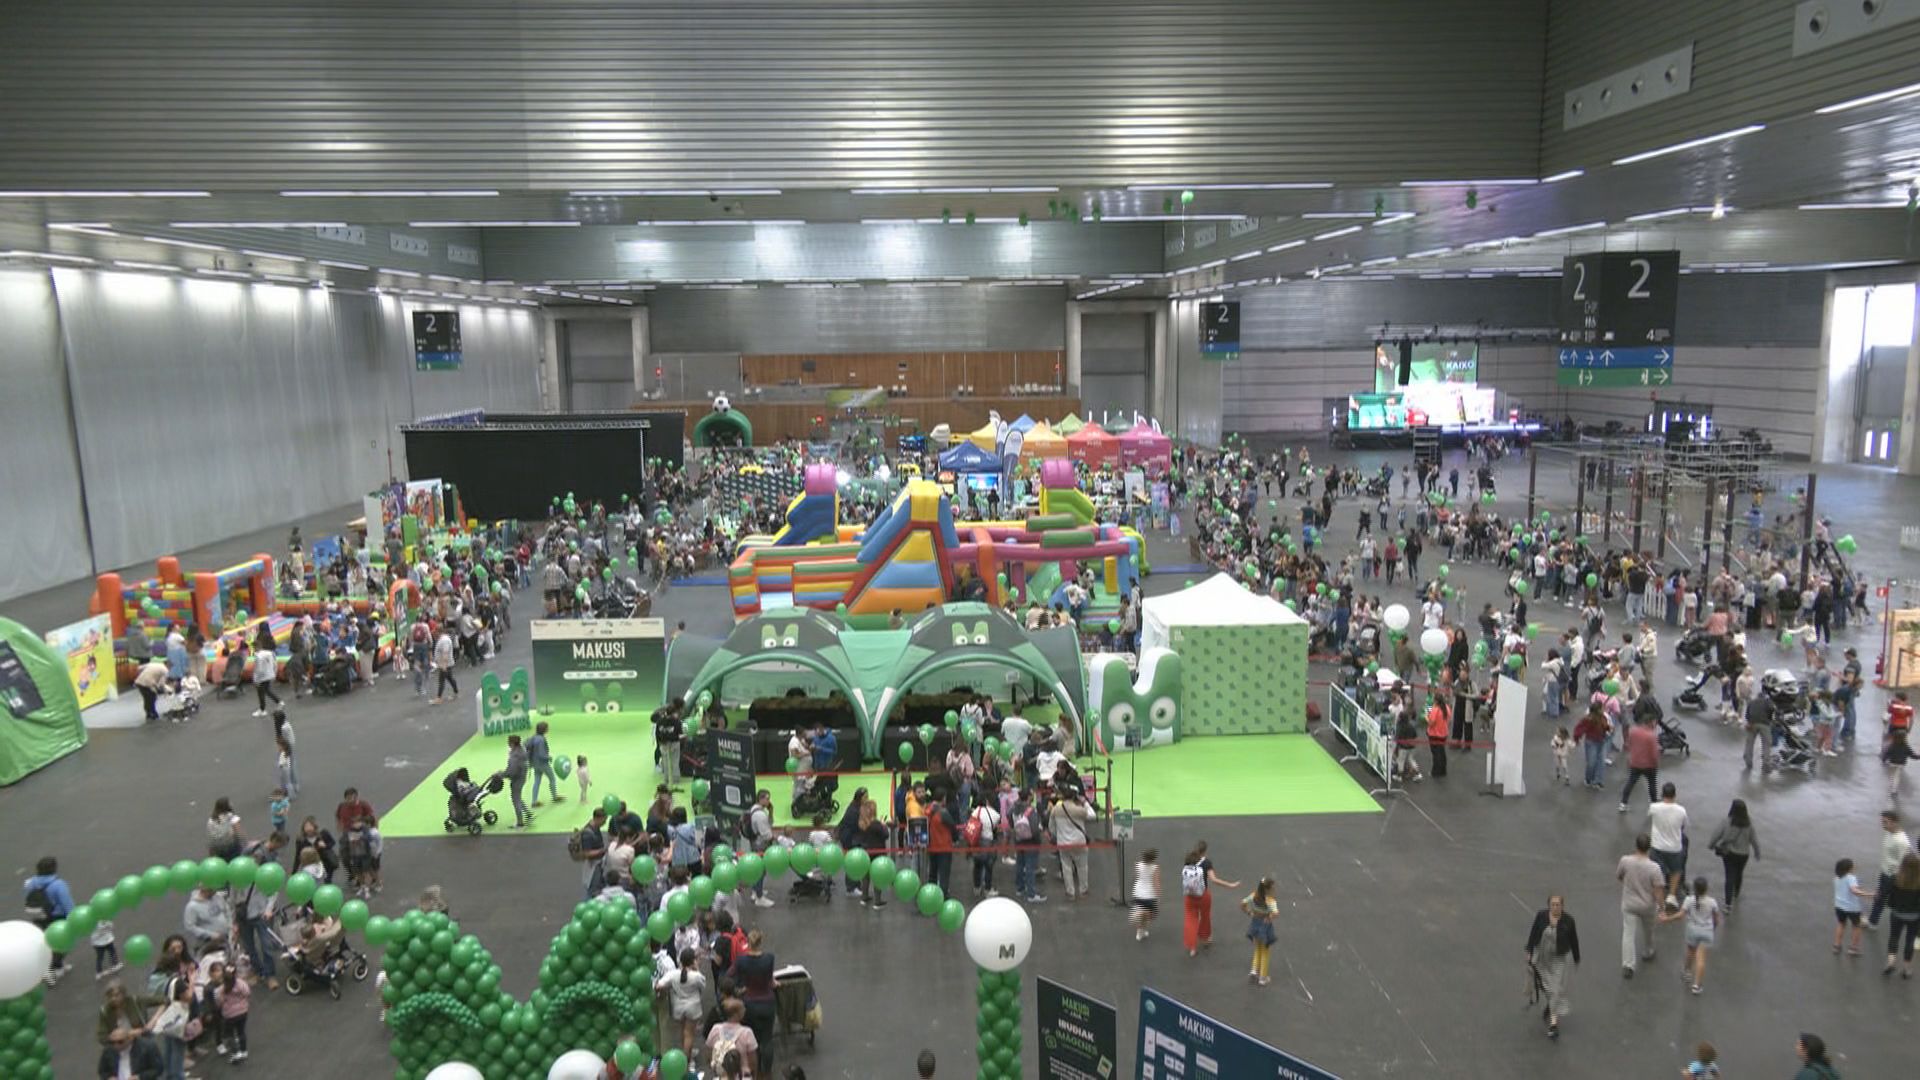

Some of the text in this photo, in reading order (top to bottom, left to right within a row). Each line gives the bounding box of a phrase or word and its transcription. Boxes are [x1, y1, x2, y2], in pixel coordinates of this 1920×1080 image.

[1574, 263, 1585, 300] 2
[1627, 259, 1650, 298] 2
[425, 314, 437, 332] 2
[1218, 304, 1229, 322] 2
[999, 943, 1015, 960] M
[1058, 1018, 1095, 1043] IRUDIAK
